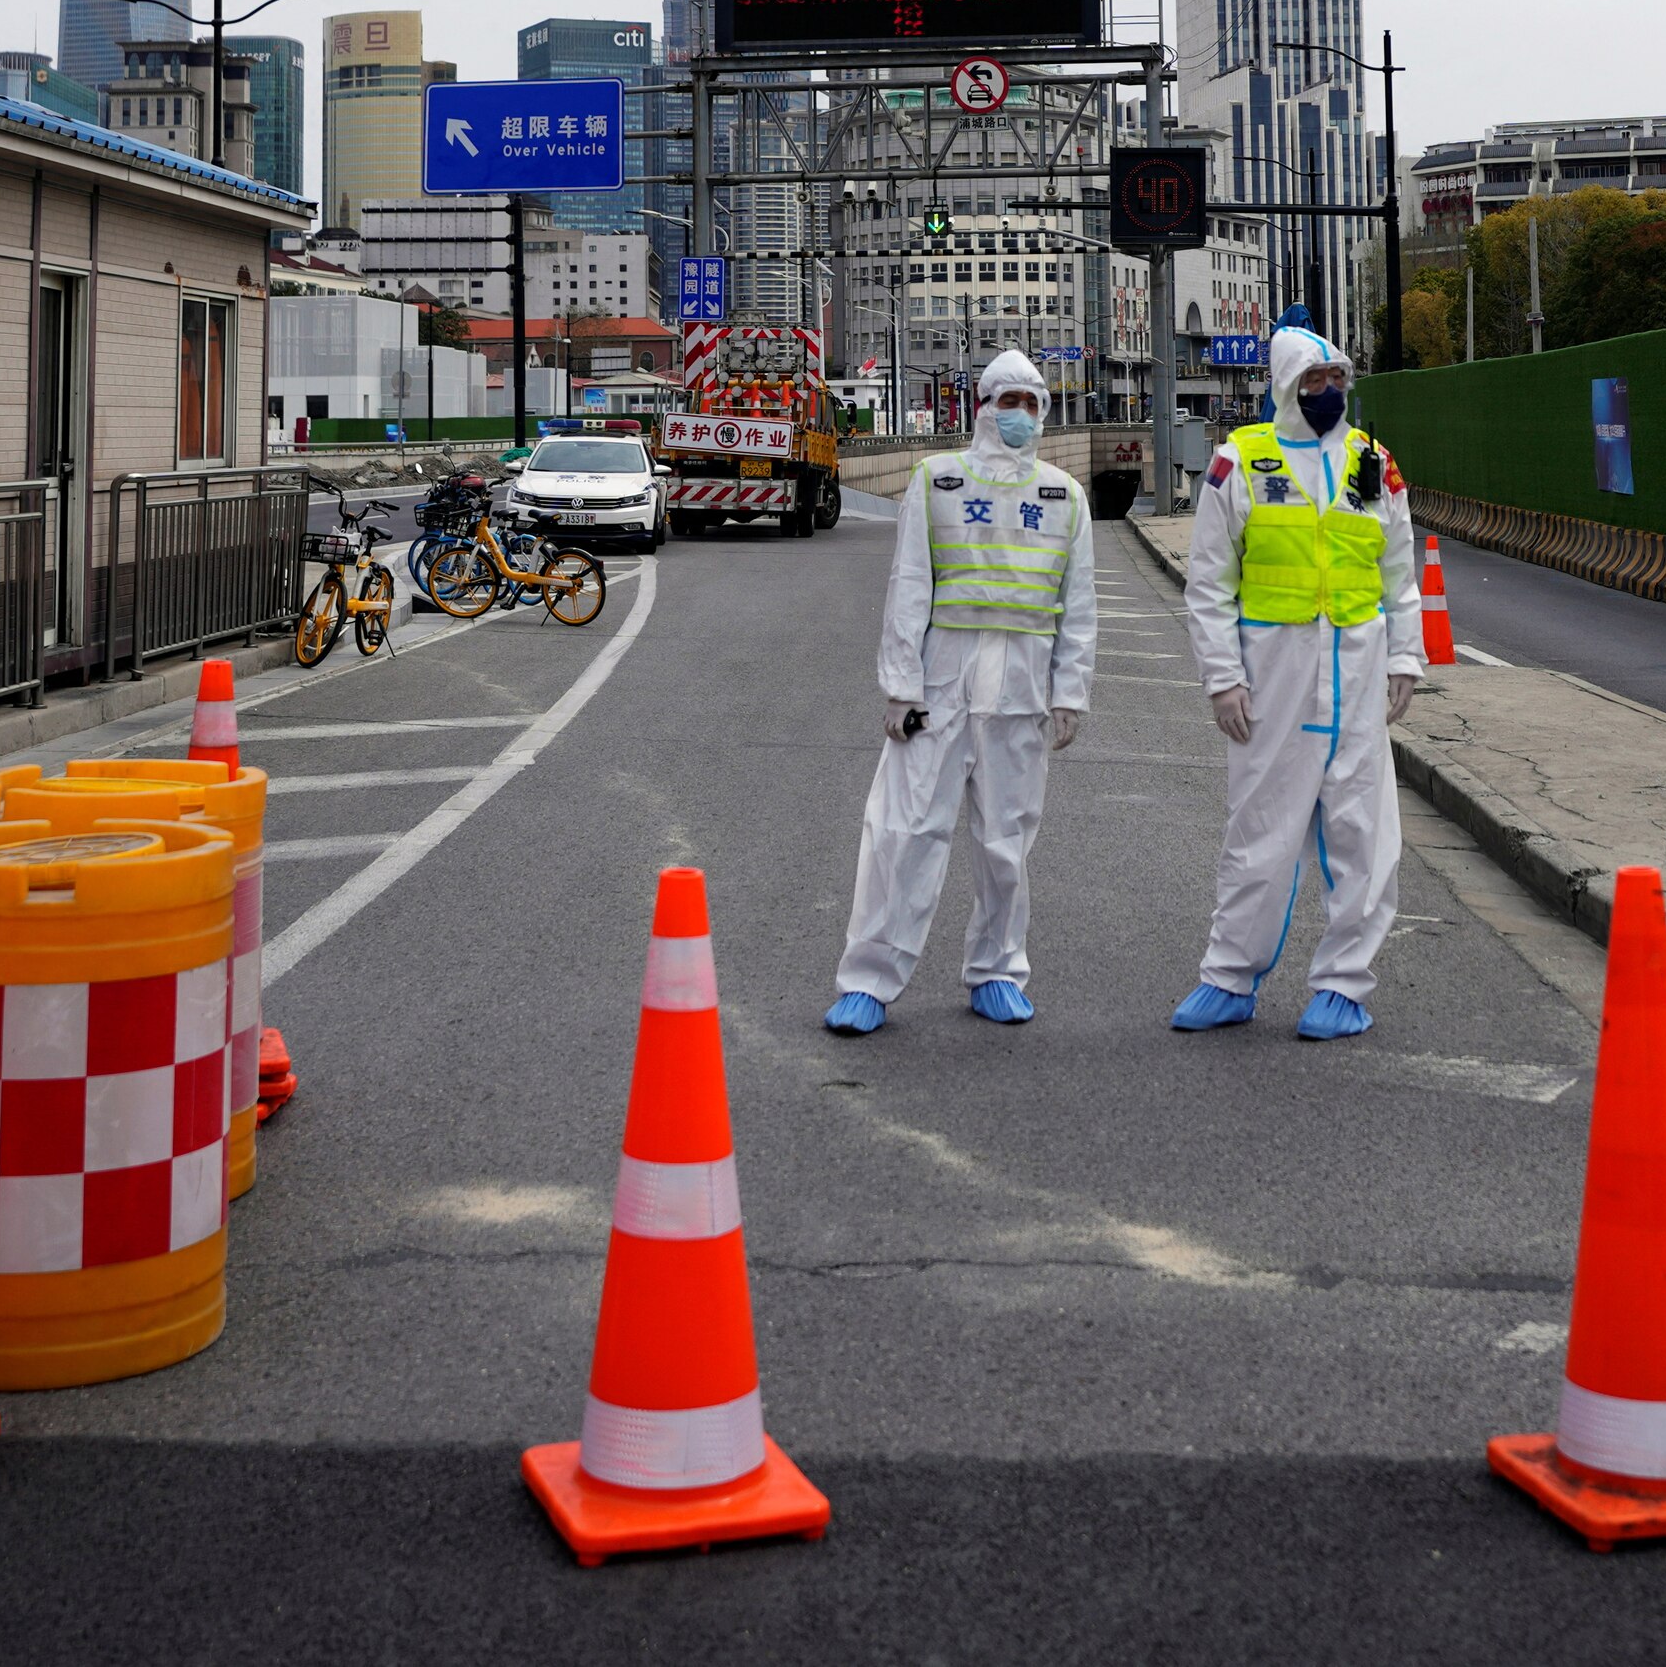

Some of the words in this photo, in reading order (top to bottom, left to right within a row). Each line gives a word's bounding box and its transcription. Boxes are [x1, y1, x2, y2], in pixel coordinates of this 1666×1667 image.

[333, 21, 391, 55] 震旦
[613, 28, 645, 47] citi
[501, 115, 608, 139] 超限车辆
[959, 116, 1008, 130] 浦城路口
[503, 144, 539, 157] Over
[546, 143, 606, 156] Vehicle
[1139, 178, 1178, 213] 40
[684, 262, 699, 295] 豫园
[705, 262, 720, 295] 隧道
